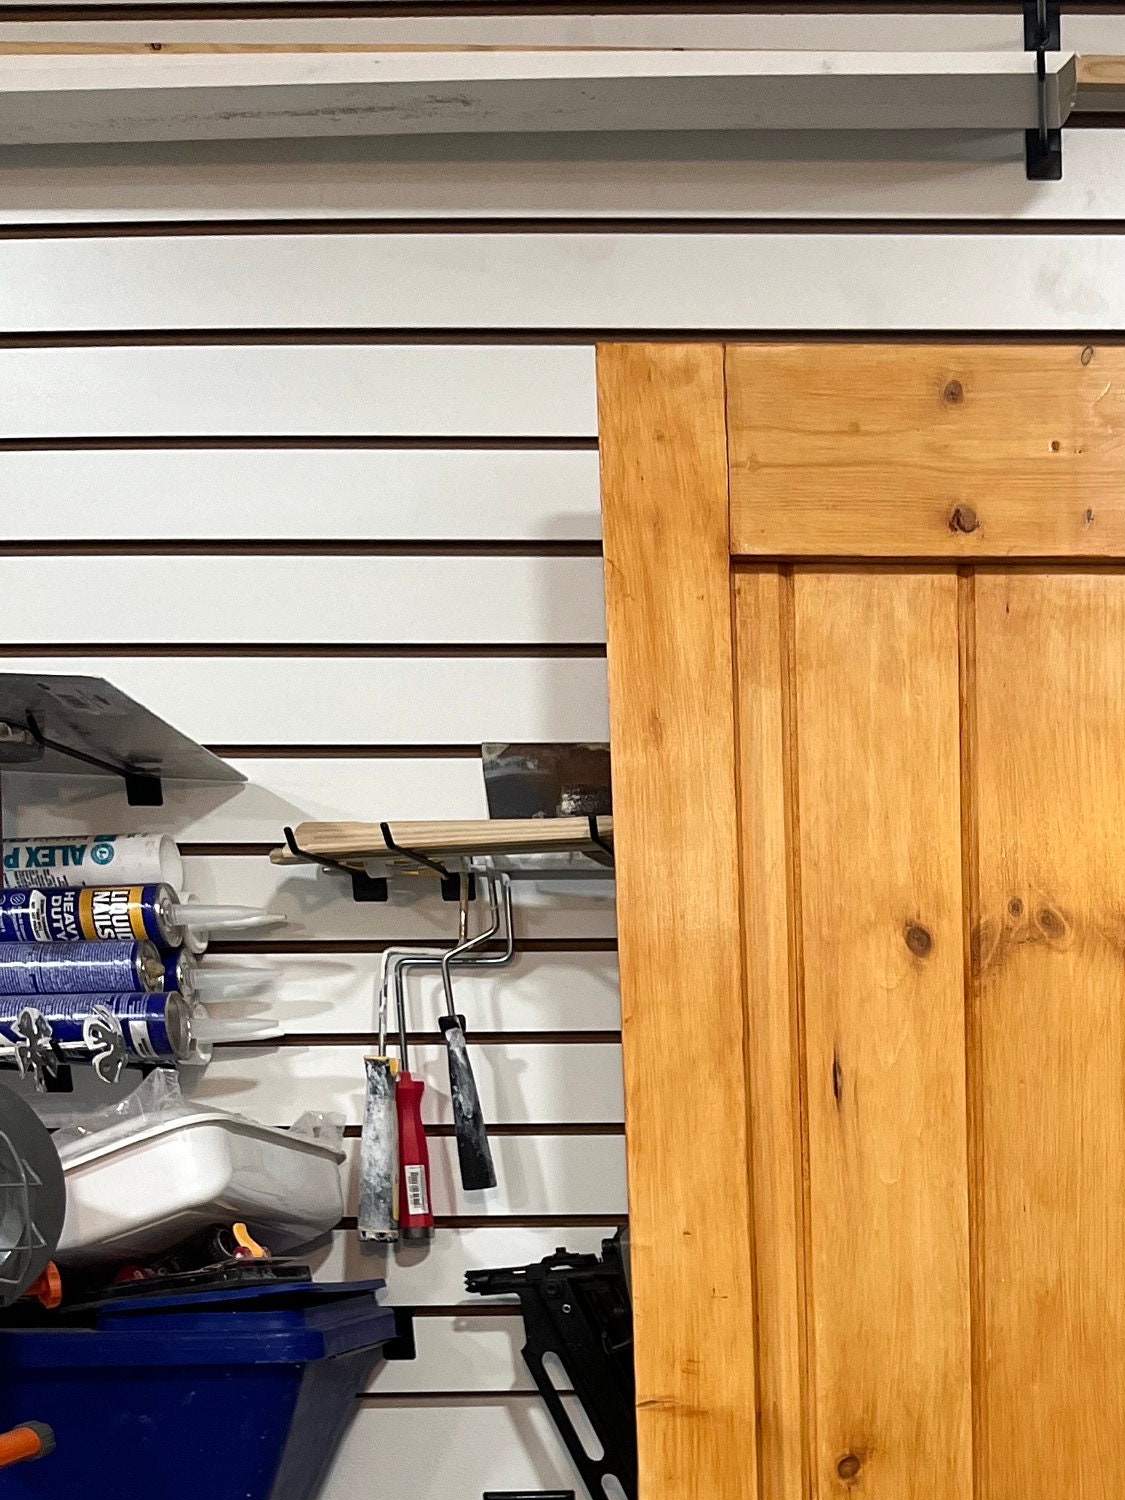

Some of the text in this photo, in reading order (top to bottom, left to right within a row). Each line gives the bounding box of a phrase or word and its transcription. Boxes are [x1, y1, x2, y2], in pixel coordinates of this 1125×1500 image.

[26, 845, 87, 868] ALEX
[51, 896, 69, 941] DUTY
[93, 891, 116, 940] NAILS
